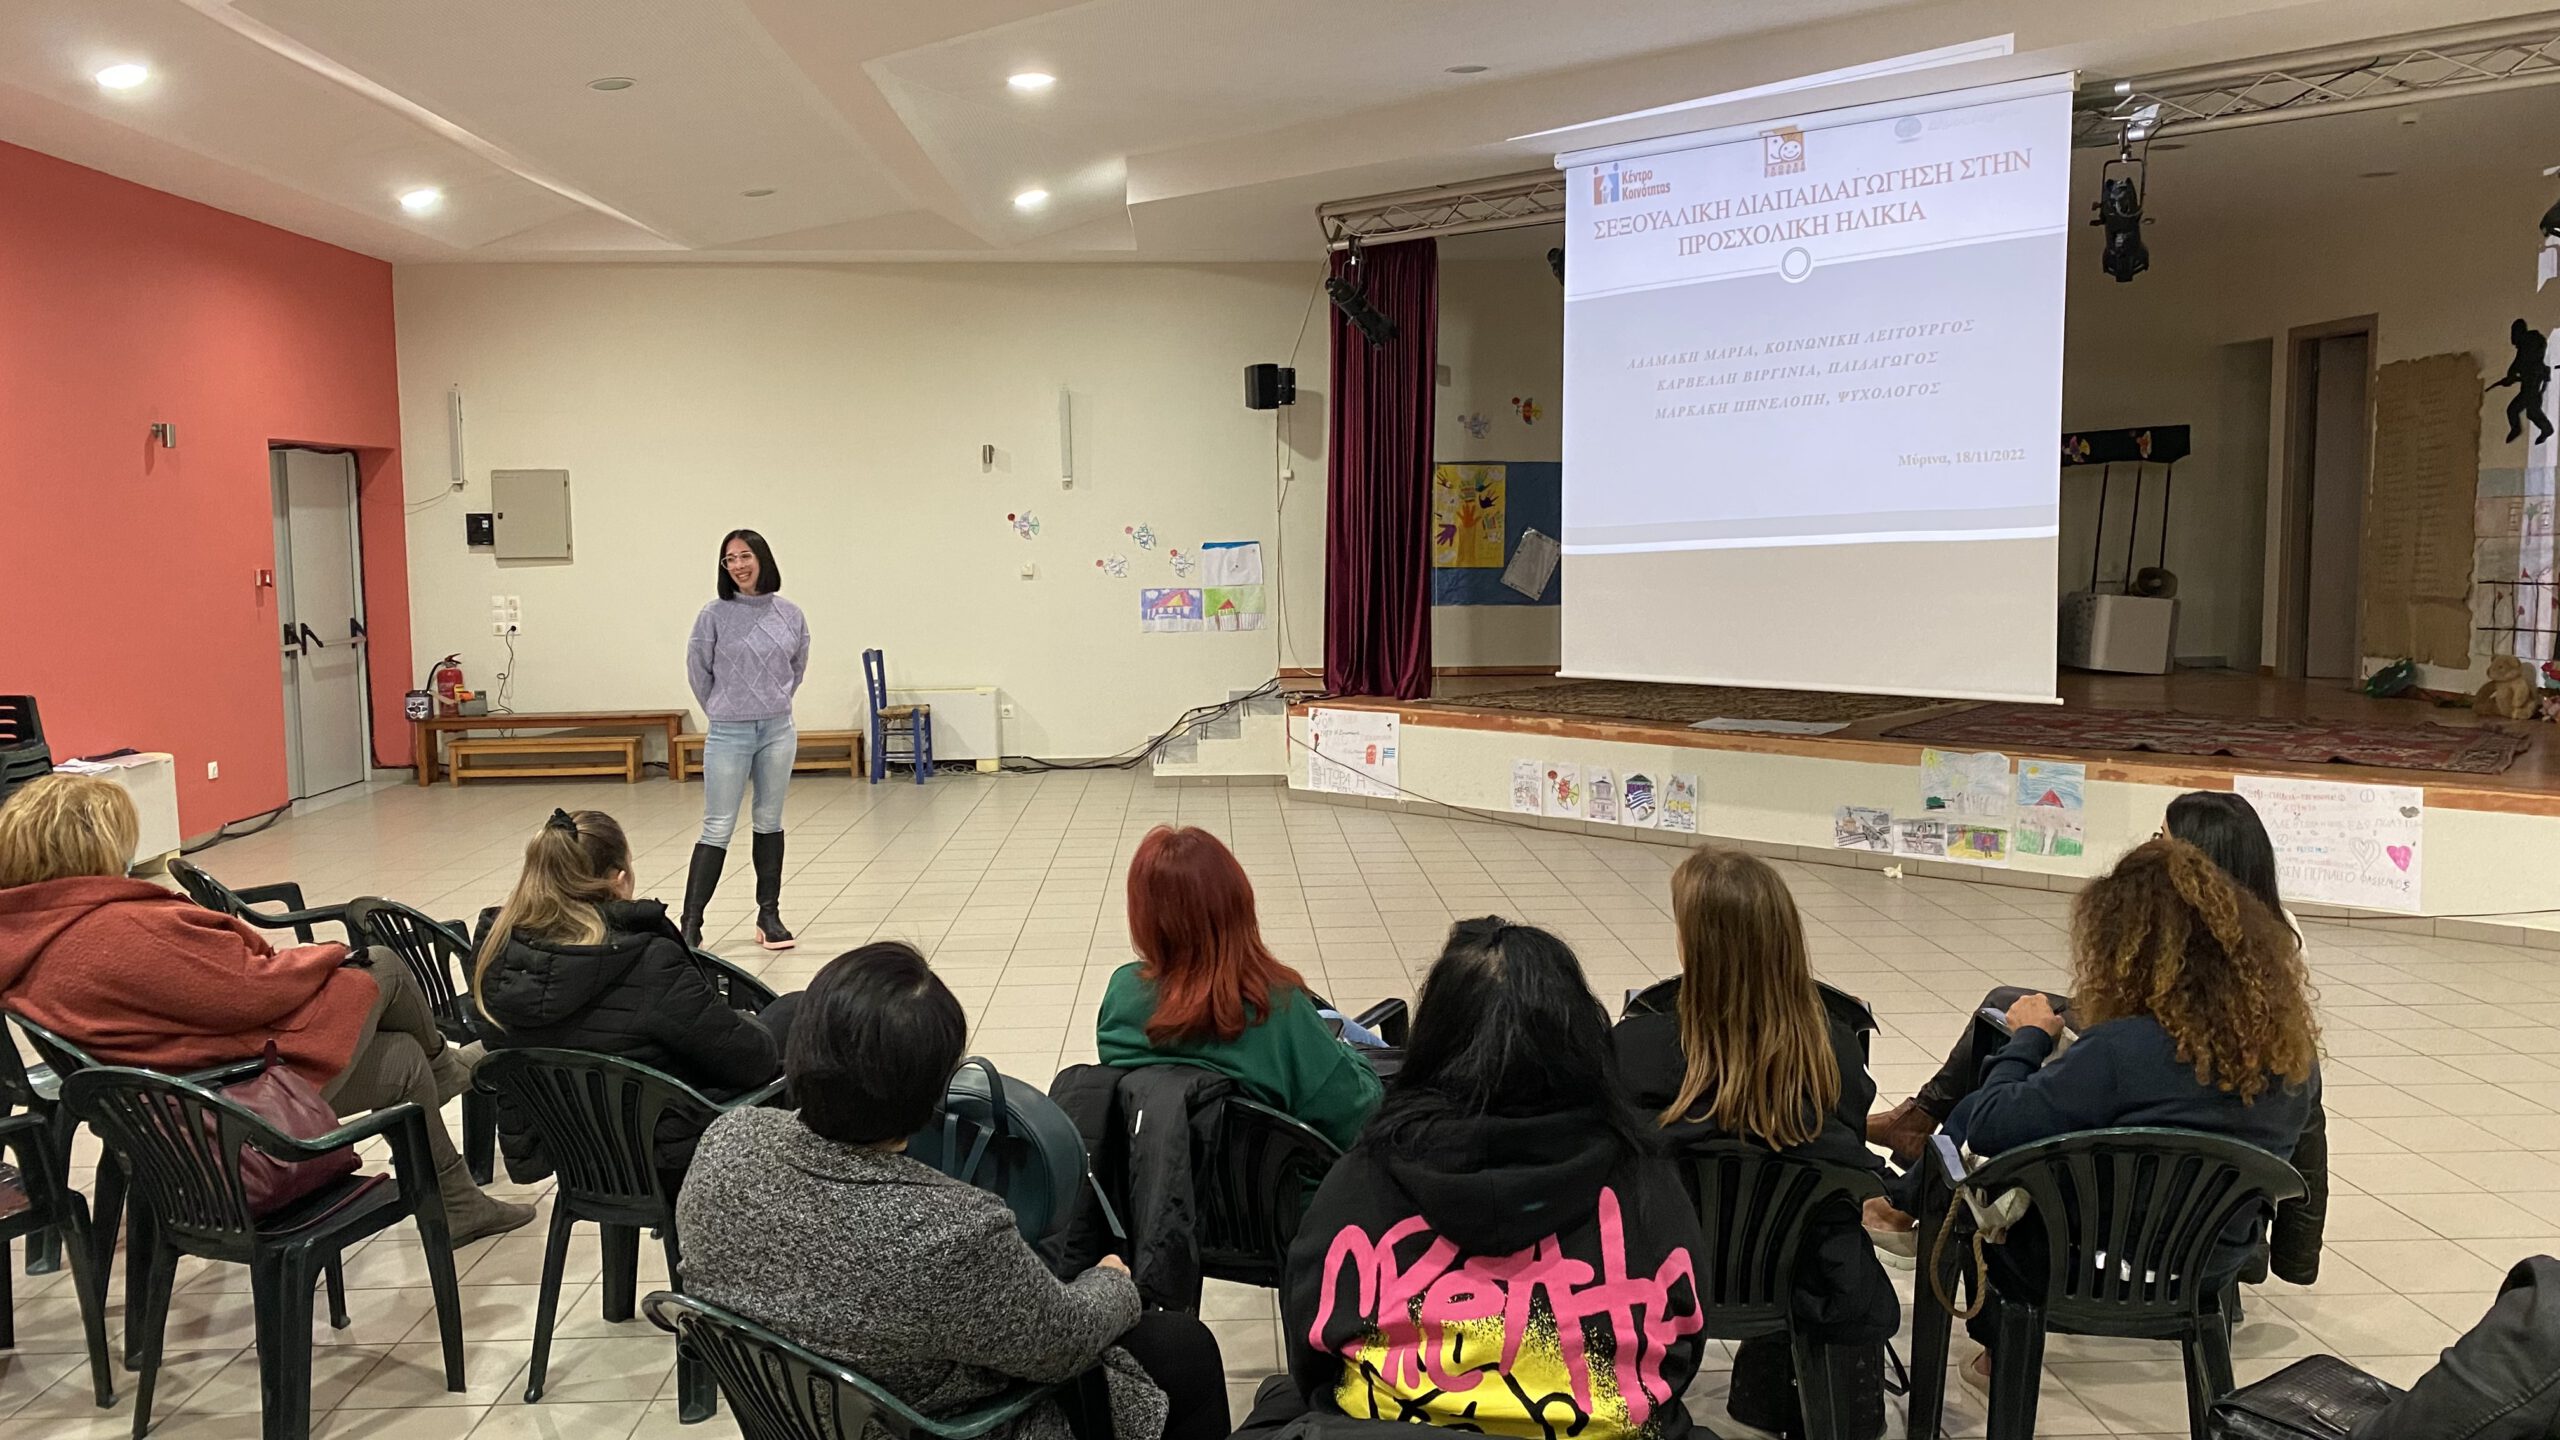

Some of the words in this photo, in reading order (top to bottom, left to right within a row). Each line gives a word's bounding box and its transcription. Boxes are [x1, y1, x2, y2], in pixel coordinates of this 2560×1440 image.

[1594, 199, 1732, 240] ΣΕΞΟΥΑΛΙΚΗ
[1736, 161, 1954, 217] ΔΙΑΠΑΙΔΑΓΩΓΗΣΗ
[1960, 147, 2032, 181] ΣΤΗΝ
[1621, 168, 1653, 185] Κέντρο
[1621, 181, 1671, 201] Κοινότητας
[1678, 214, 1829, 256] ΠΡΟΣΧΟΛΙΚΗ
[1836, 200, 1927, 233] ΗΛΙΚΙΑ
[1627, 351, 1699, 370] ΑΔΑΜΑΚΗ
[1703, 345, 1758, 361] ΜΑΡΙΑ,
[1764, 333, 1860, 354] ΚΟΙΝΩΝΙΚΗ
[1865, 319, 1975, 343] ΛΕΙΤΟΥΡΓΟΣ
[1743, 364, 1821, 383] ΒΙΡΓΙΝΙΑ,
[1828, 351, 1939, 375] ΠΑΙΔΑΓΩΓΟΣ
[1655, 402, 1728, 420] ΜΑΡΚΑΚΗ
[1733, 393, 1831, 414] ΠΗΝΕΛΟΠΗ,
[1838, 382, 1941, 403] ΨΥΧΟΛΟΓΟΣ
[1898, 454, 1951, 468] Μύρινα,
[1956, 449, 2026, 464] 18/11/2022
